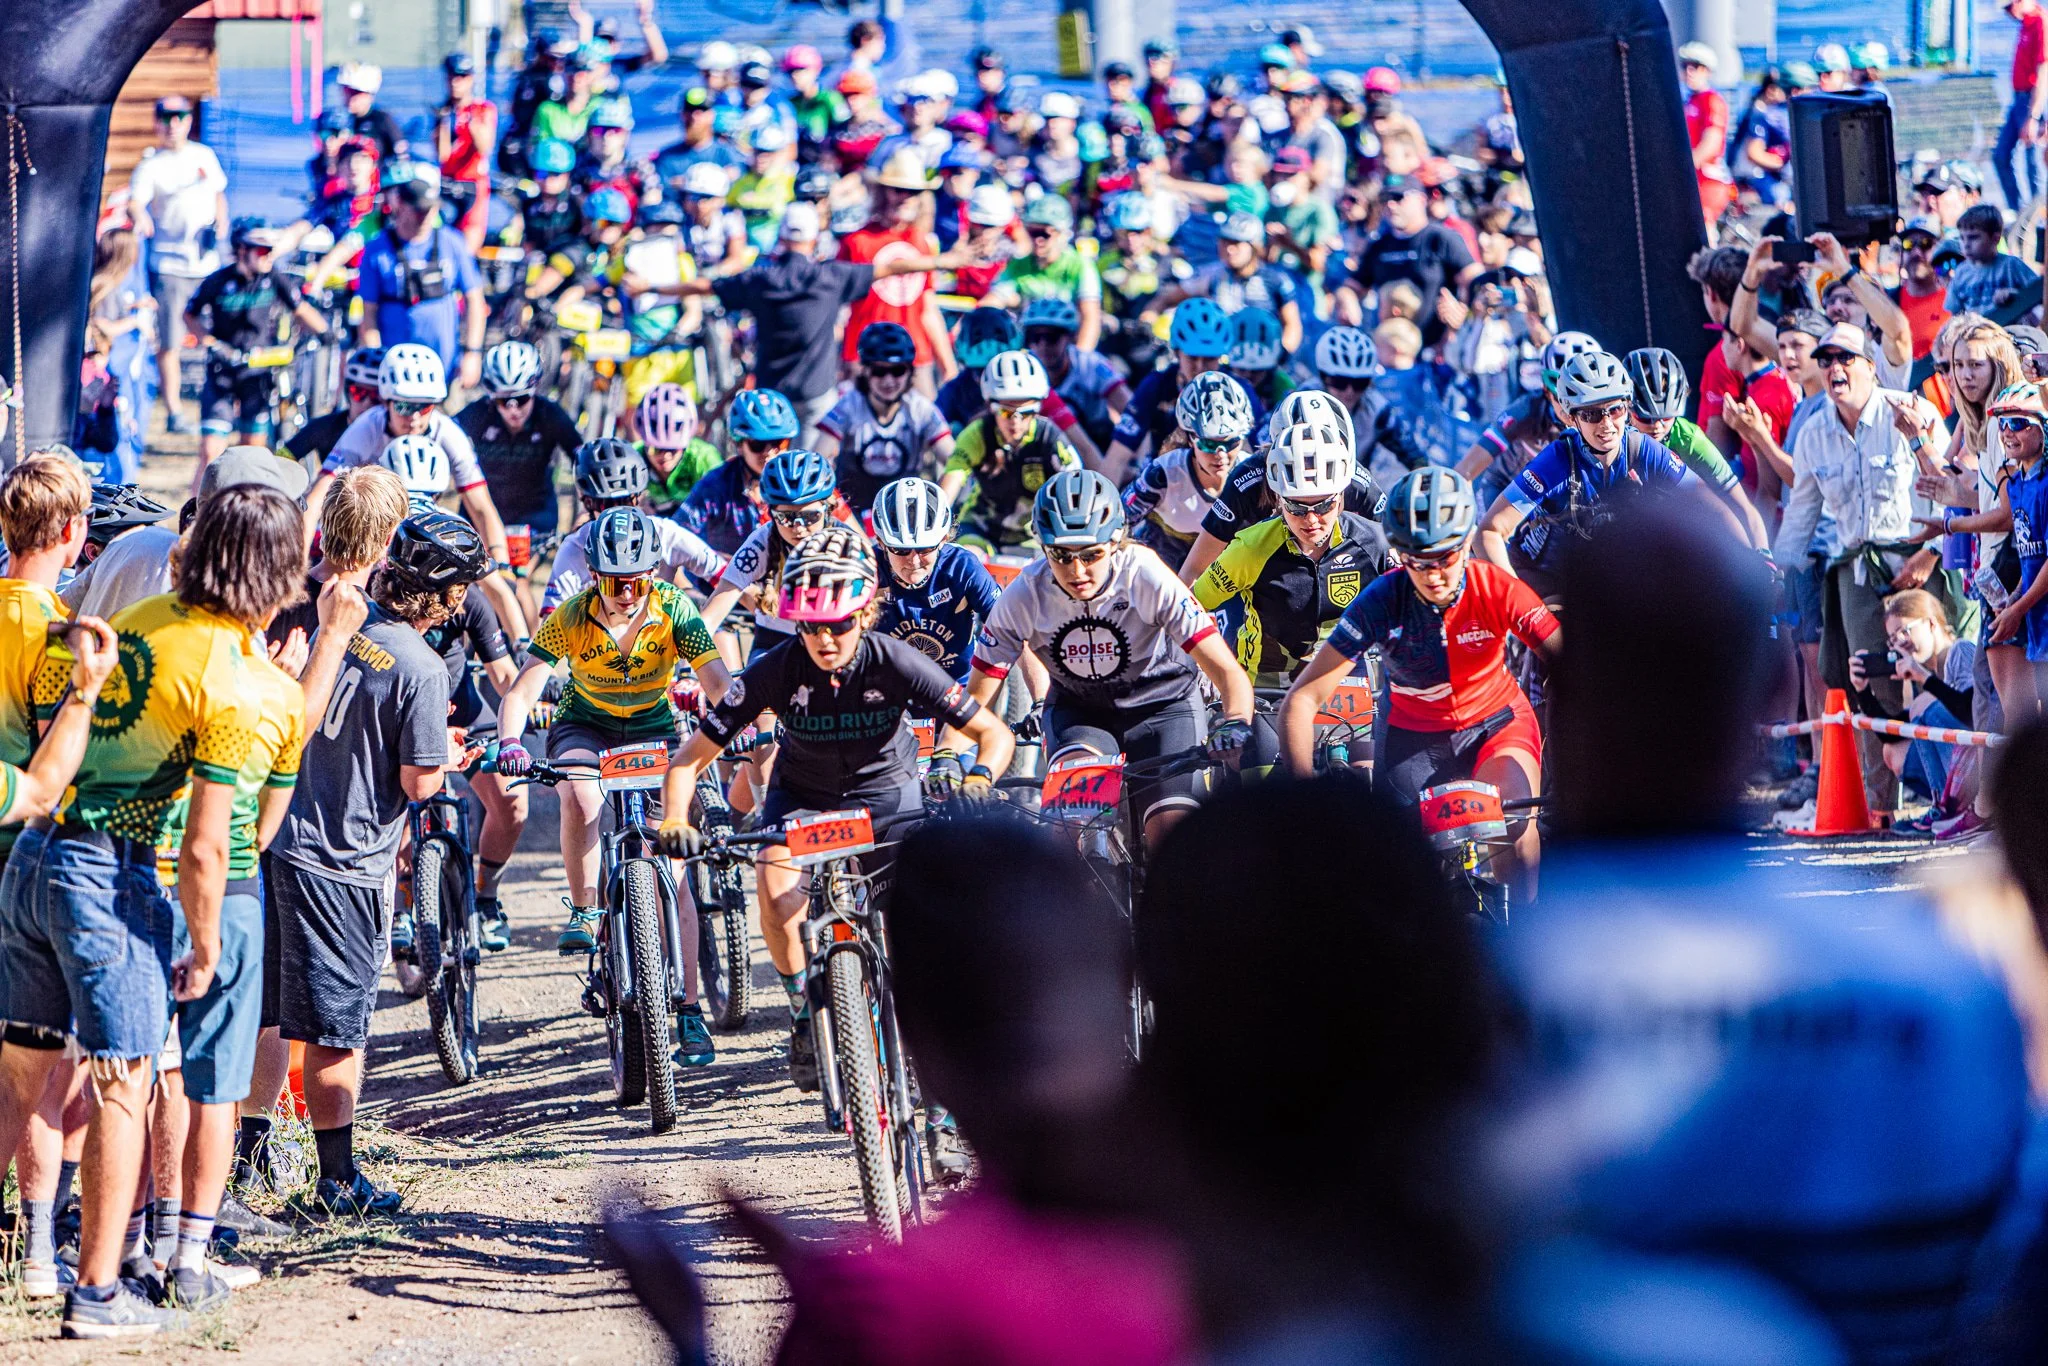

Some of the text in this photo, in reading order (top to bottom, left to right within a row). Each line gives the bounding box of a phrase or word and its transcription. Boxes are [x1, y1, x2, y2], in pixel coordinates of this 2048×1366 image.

[1233, 469, 1257, 487] DUTCH
[614, 512, 629, 536] FOX
[451, 547, 470, 563] SMITH
[1331, 574, 1358, 583] EHS
[1067, 641, 1113, 657] BOISE
[639, 667, 660, 680] BIKE
[840, 706, 900, 729] RIVER
[837, 730, 862, 742] BIKE
[614, 755, 655, 769] 446
[1060, 776, 1106, 793] 447
[1437, 798, 1485, 819] 439
[805, 827, 854, 845] 428
